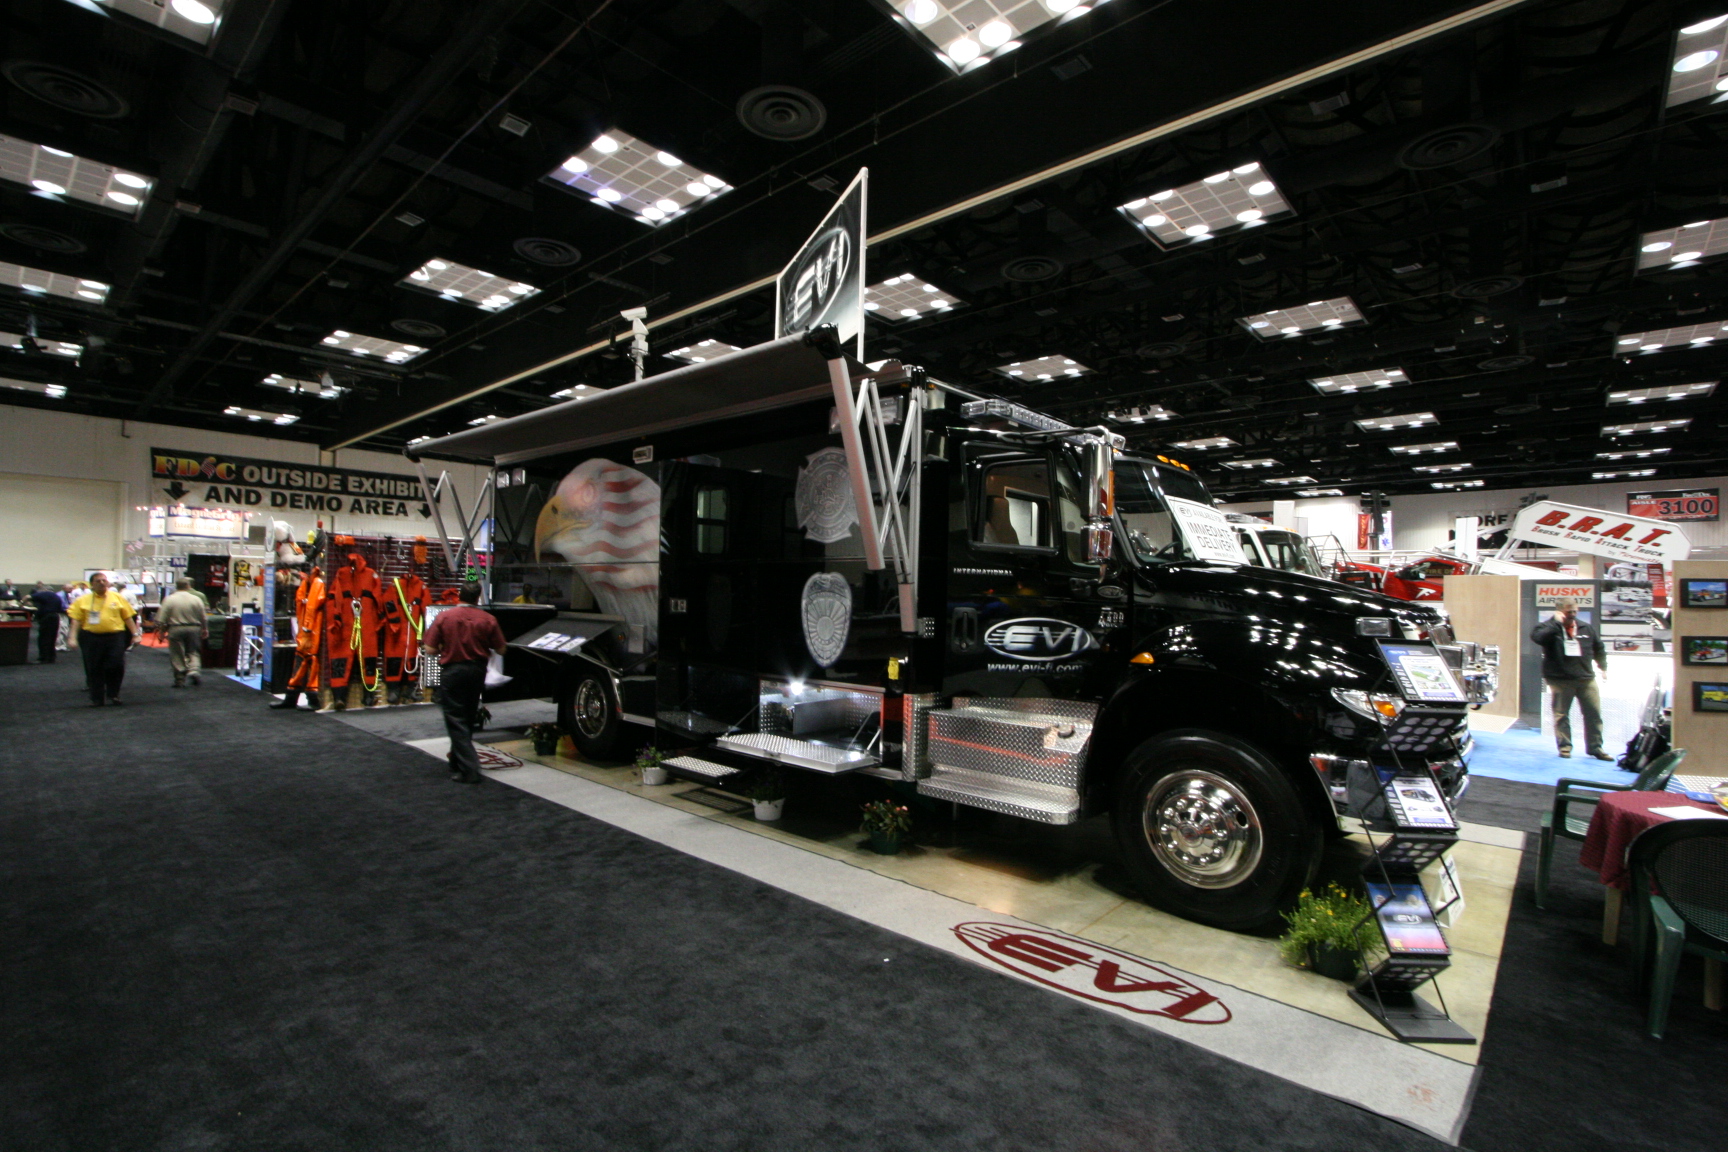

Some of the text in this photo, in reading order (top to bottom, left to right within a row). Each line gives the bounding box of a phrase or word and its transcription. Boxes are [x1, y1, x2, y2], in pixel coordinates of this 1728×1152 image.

[794, 230, 845, 328] EVI
[154, 455, 437, 499] FDIC OUTSIDE EXHIBIT
[204, 485, 408, 516] AND DEMO AREA
[1659, 499, 1714, 515] 3100
[1187, 522, 1233, 541] IMMEDIATE
[1535, 510, 1672, 547] B.R.A.T.
[1197, 536, 1237, 552] DELIVERY
[953, 568, 1013, 576] INTERNATIONAL
[1538, 597, 1592, 605] AIRATS
[1539, 587, 1591, 596] HUSKY
[1001, 625, 1083, 652] EVI
[988, 934, 1220, 1018] EVI
